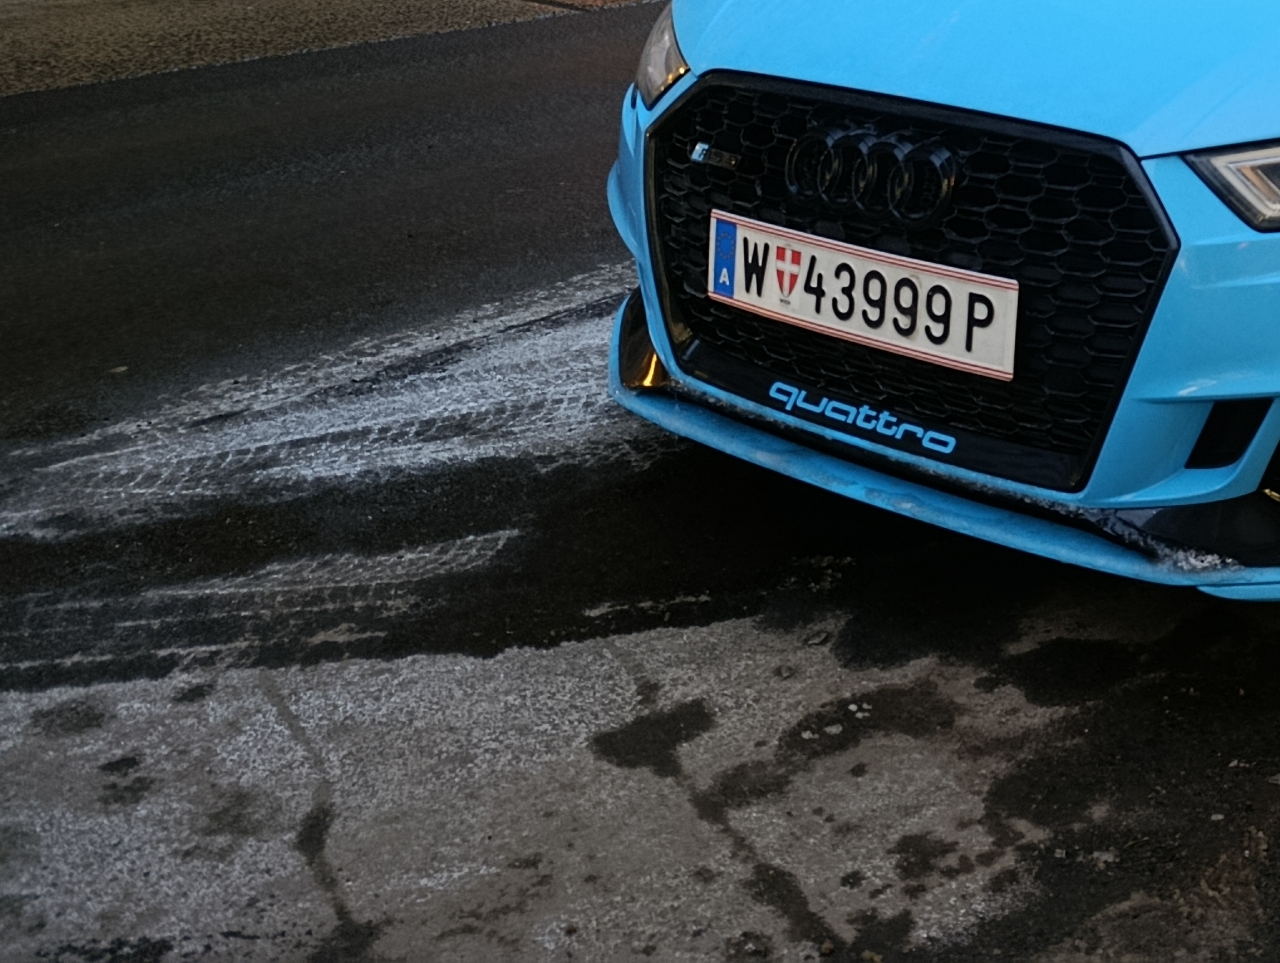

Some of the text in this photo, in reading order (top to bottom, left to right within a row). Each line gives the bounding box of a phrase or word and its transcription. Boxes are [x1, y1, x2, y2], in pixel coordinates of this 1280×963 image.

[718, 267, 730, 286] A
[743, 237, 769, 297] W
[769, 381, 957, 454] quattro
